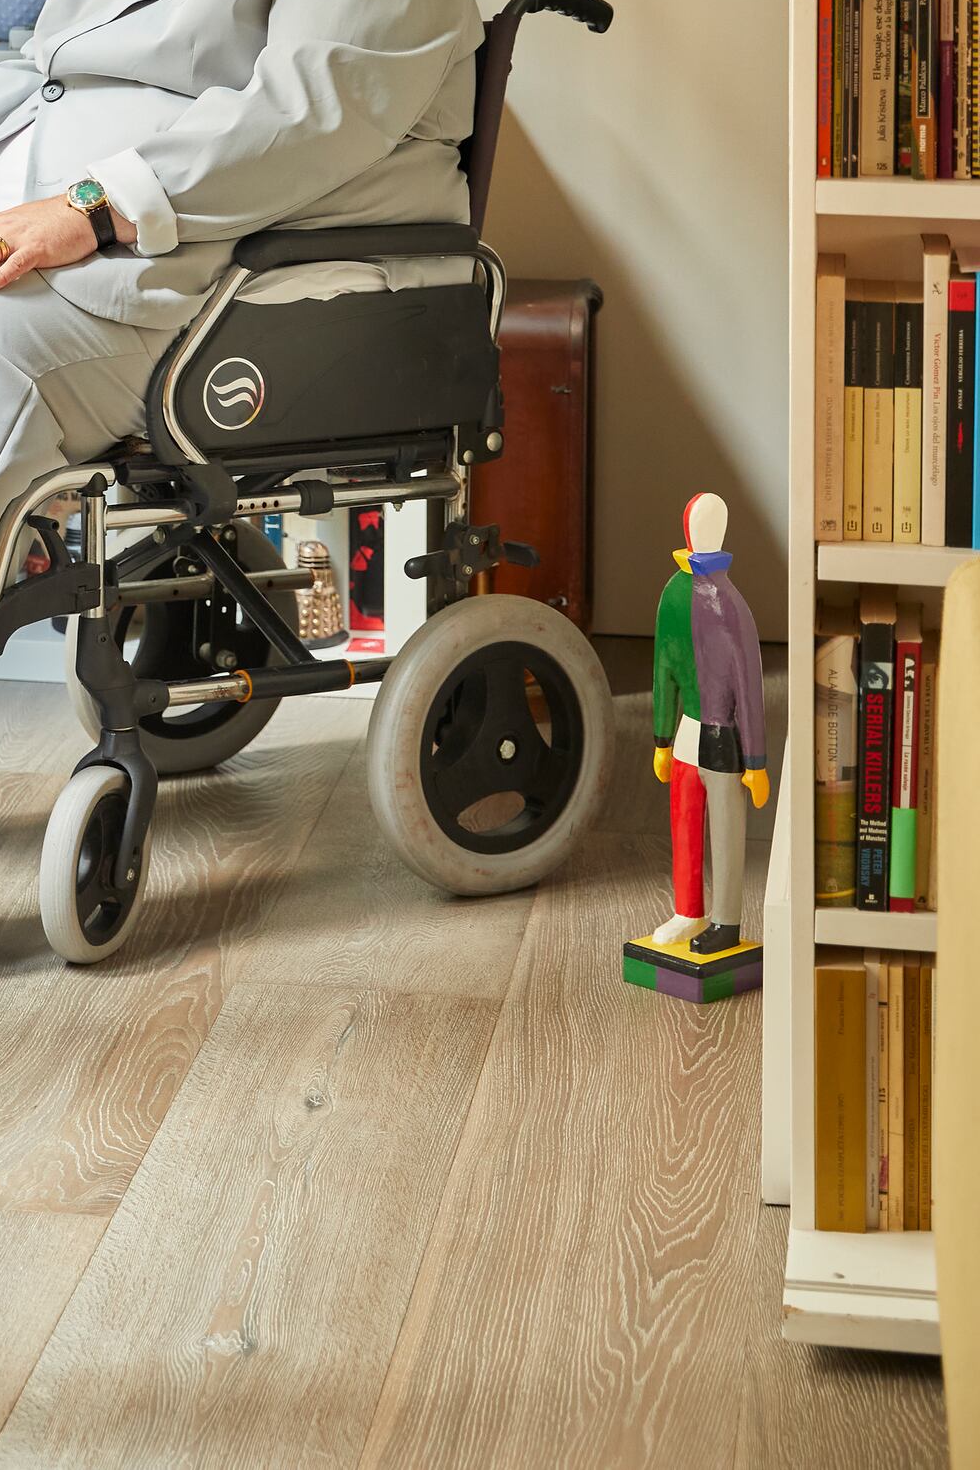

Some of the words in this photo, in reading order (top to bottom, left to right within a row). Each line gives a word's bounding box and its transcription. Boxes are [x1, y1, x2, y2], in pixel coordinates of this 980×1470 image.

[873, 73, 882, 81] El
[877, 89, 887, 122] Kristeva
[919, 91, 927, 113] Marco
[877, 124, 887, 142] Julia
[919, 124, 927, 152] norma
[932, 359, 941, 385] Gómez
[825, 396, 833, 445] ISHERWOOD
[931, 416, 939, 431] ojos
[932, 432, 940, 444] del
[824, 447, 833, 501] CHRISTOPHER
[930, 446, 940, 486] murciélago
[827, 669, 838, 698] ALAIN
[828, 704, 838, 717] DE
[865, 693, 884, 746] SERIAL
[828, 721, 838, 761] BOTTON
[864, 751, 883, 814] KILLERS
[861, 848, 871, 887] VRONSKY
[873, 848, 883, 875] PETER
